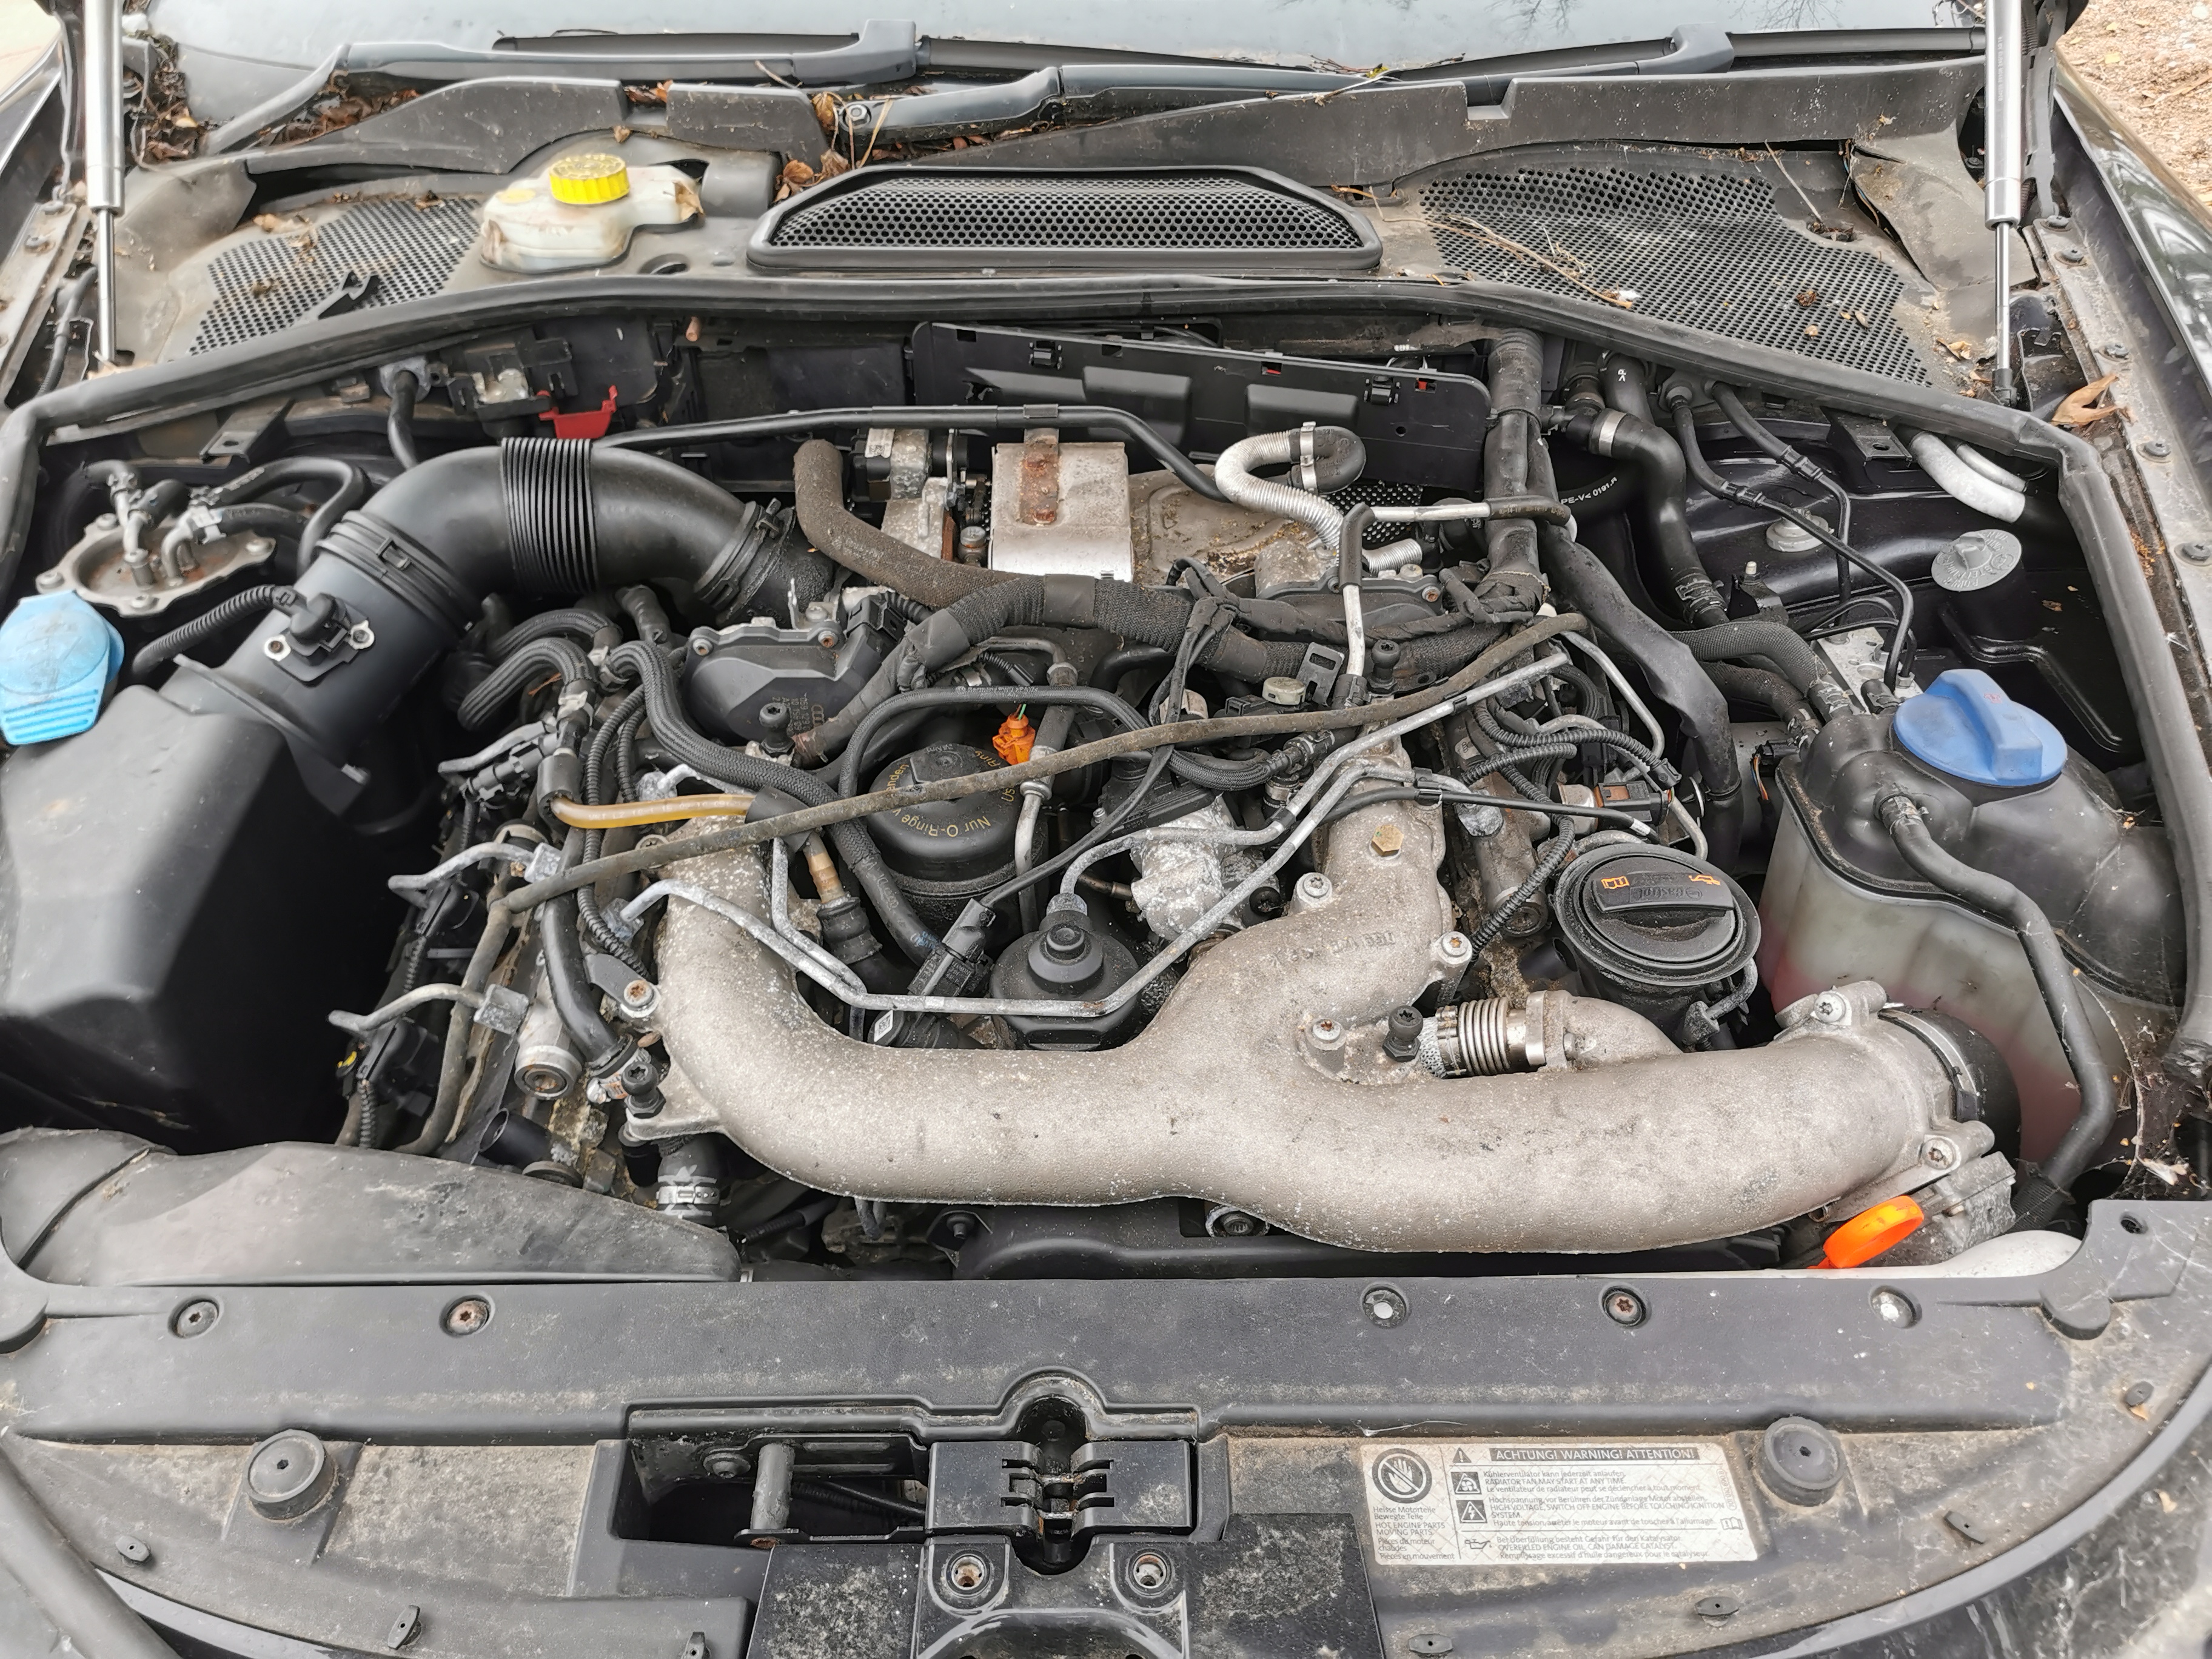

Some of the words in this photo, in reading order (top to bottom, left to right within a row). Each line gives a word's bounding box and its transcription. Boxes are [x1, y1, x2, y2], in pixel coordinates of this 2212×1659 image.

[901, 814, 959, 837] O-Ringe
[964, 816, 991, 833] Nur
[1496, 1450, 1558, 1460] ACHTUNG!
[1560, 1450, 1623, 1460] WARNING!
[1626, 1449, 1695, 1459] ATTENTION!
